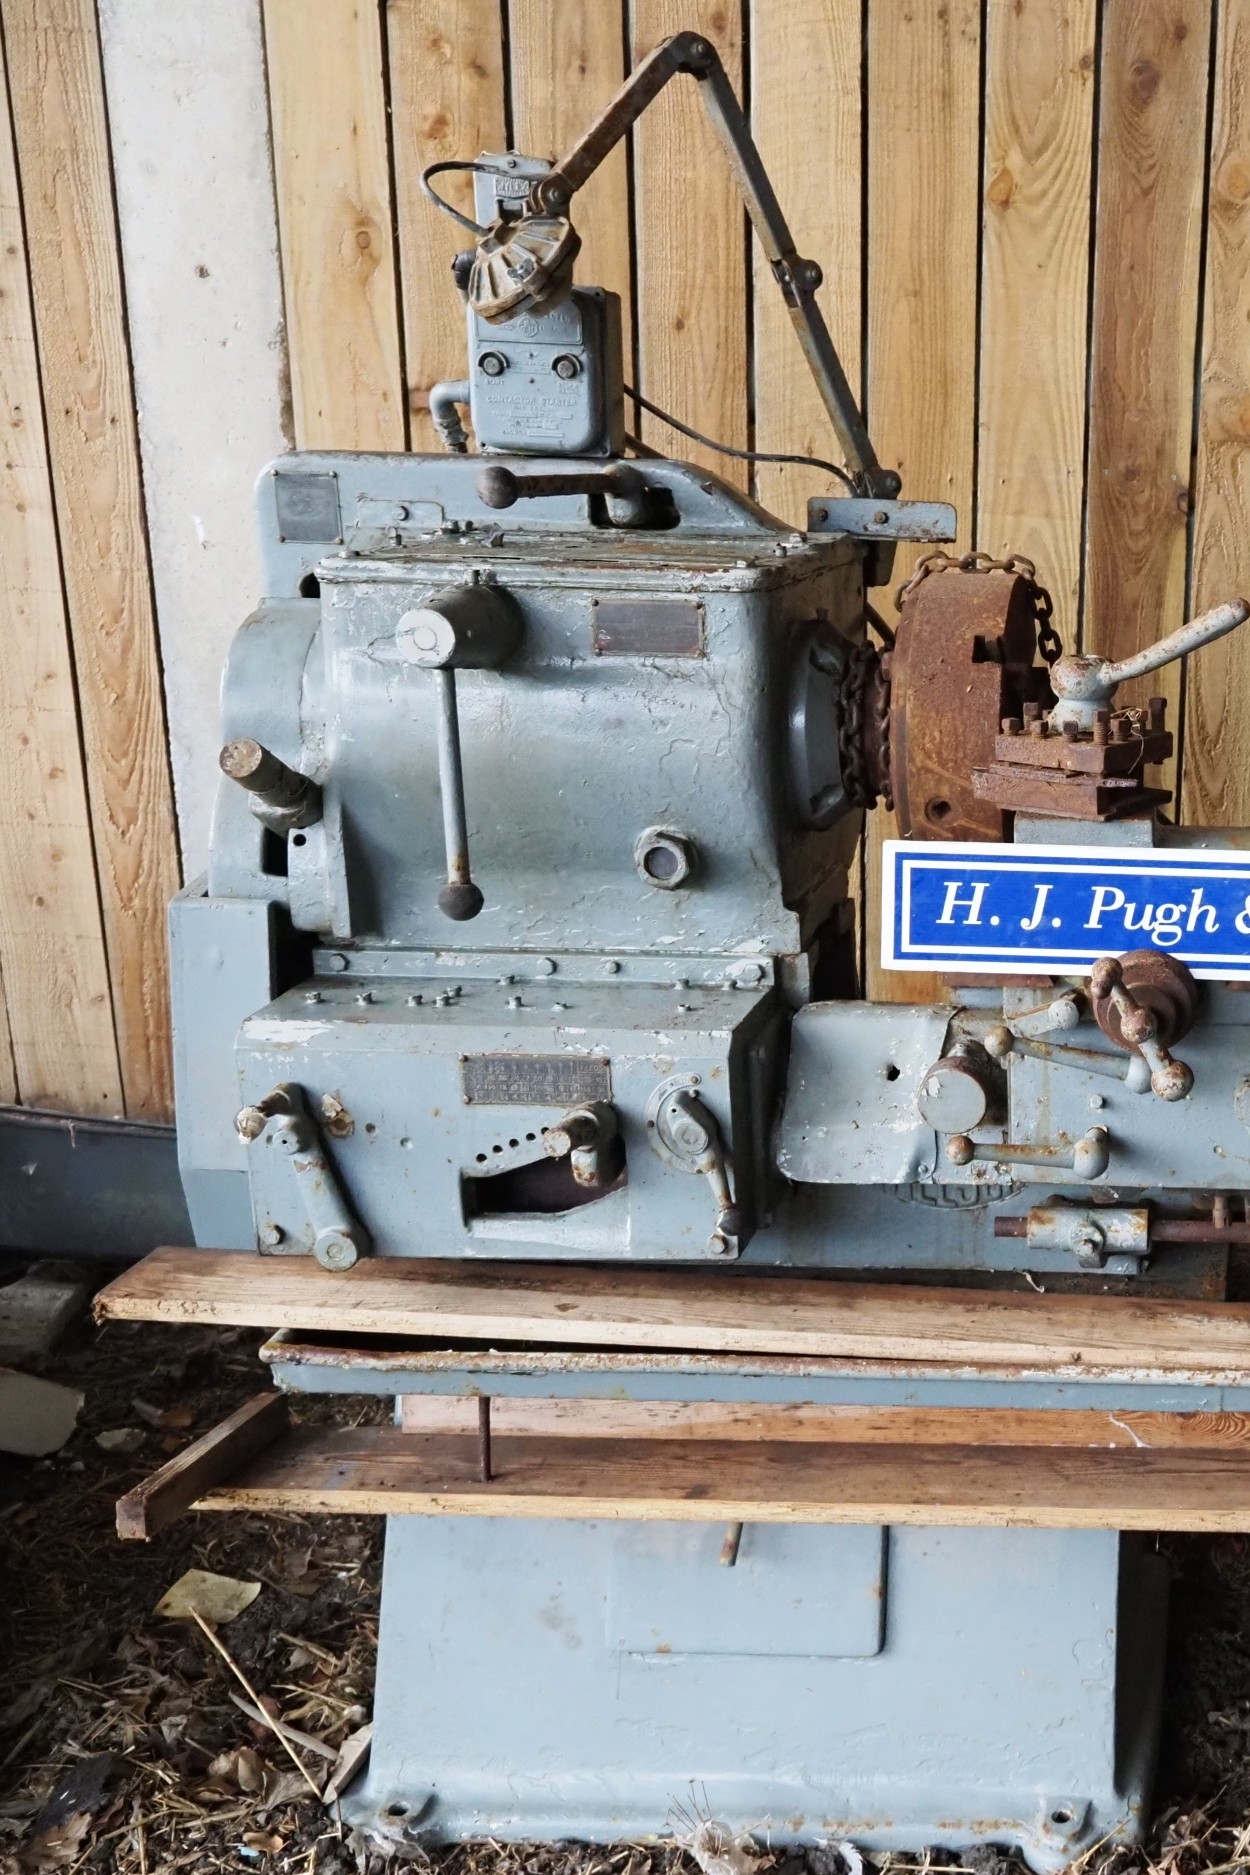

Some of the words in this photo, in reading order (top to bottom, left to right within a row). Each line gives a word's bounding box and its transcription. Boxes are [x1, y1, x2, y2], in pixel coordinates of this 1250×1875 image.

[935, 881, 1000, 926] H.
[1020, 884, 1062, 931] J.
[1083, 886, 1220, 947] Pugh
